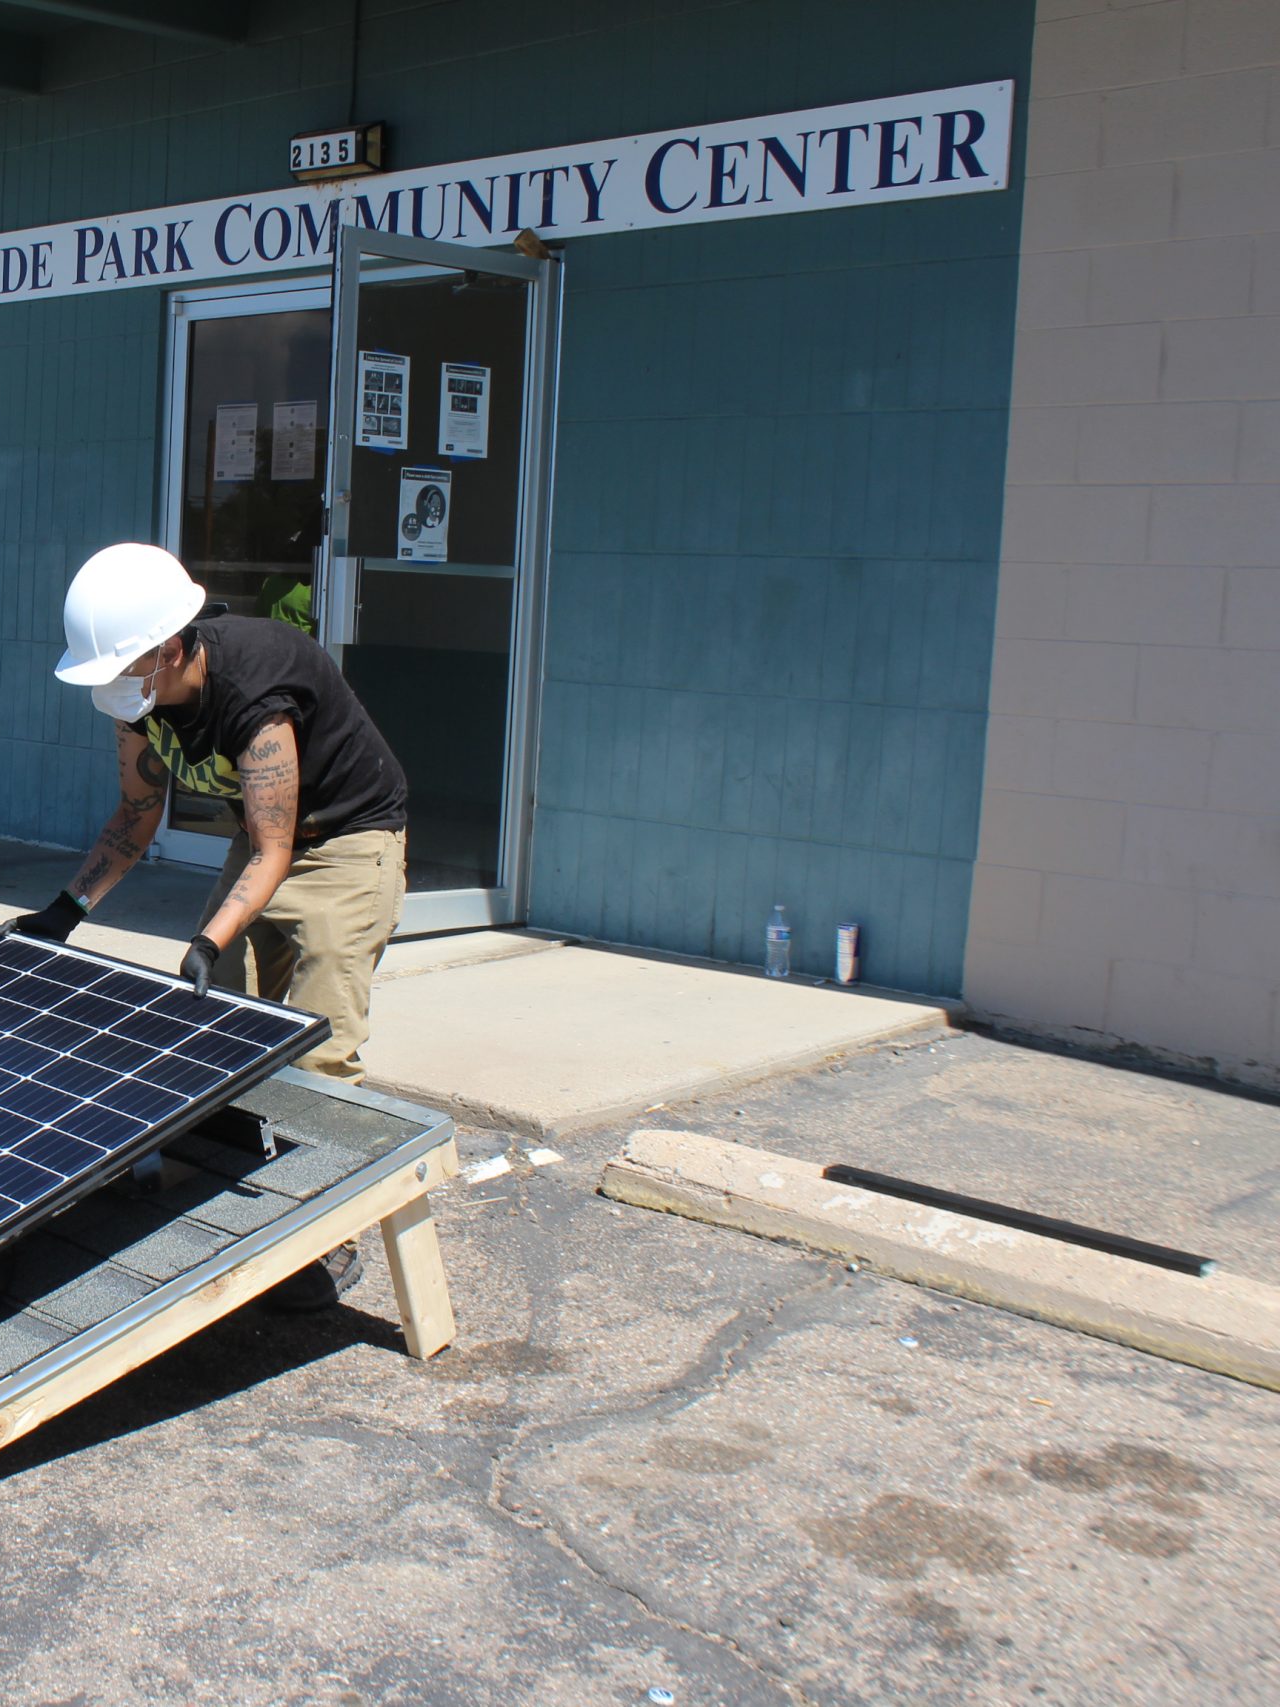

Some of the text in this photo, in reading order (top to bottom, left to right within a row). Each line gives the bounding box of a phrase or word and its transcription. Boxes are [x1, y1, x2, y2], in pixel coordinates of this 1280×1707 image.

[72, 219, 194, 285] PARK
[214, 158, 618, 266] COMMUNITY
[644, 109, 989, 214] CENTER
[292, 138, 350, 168] 2135
